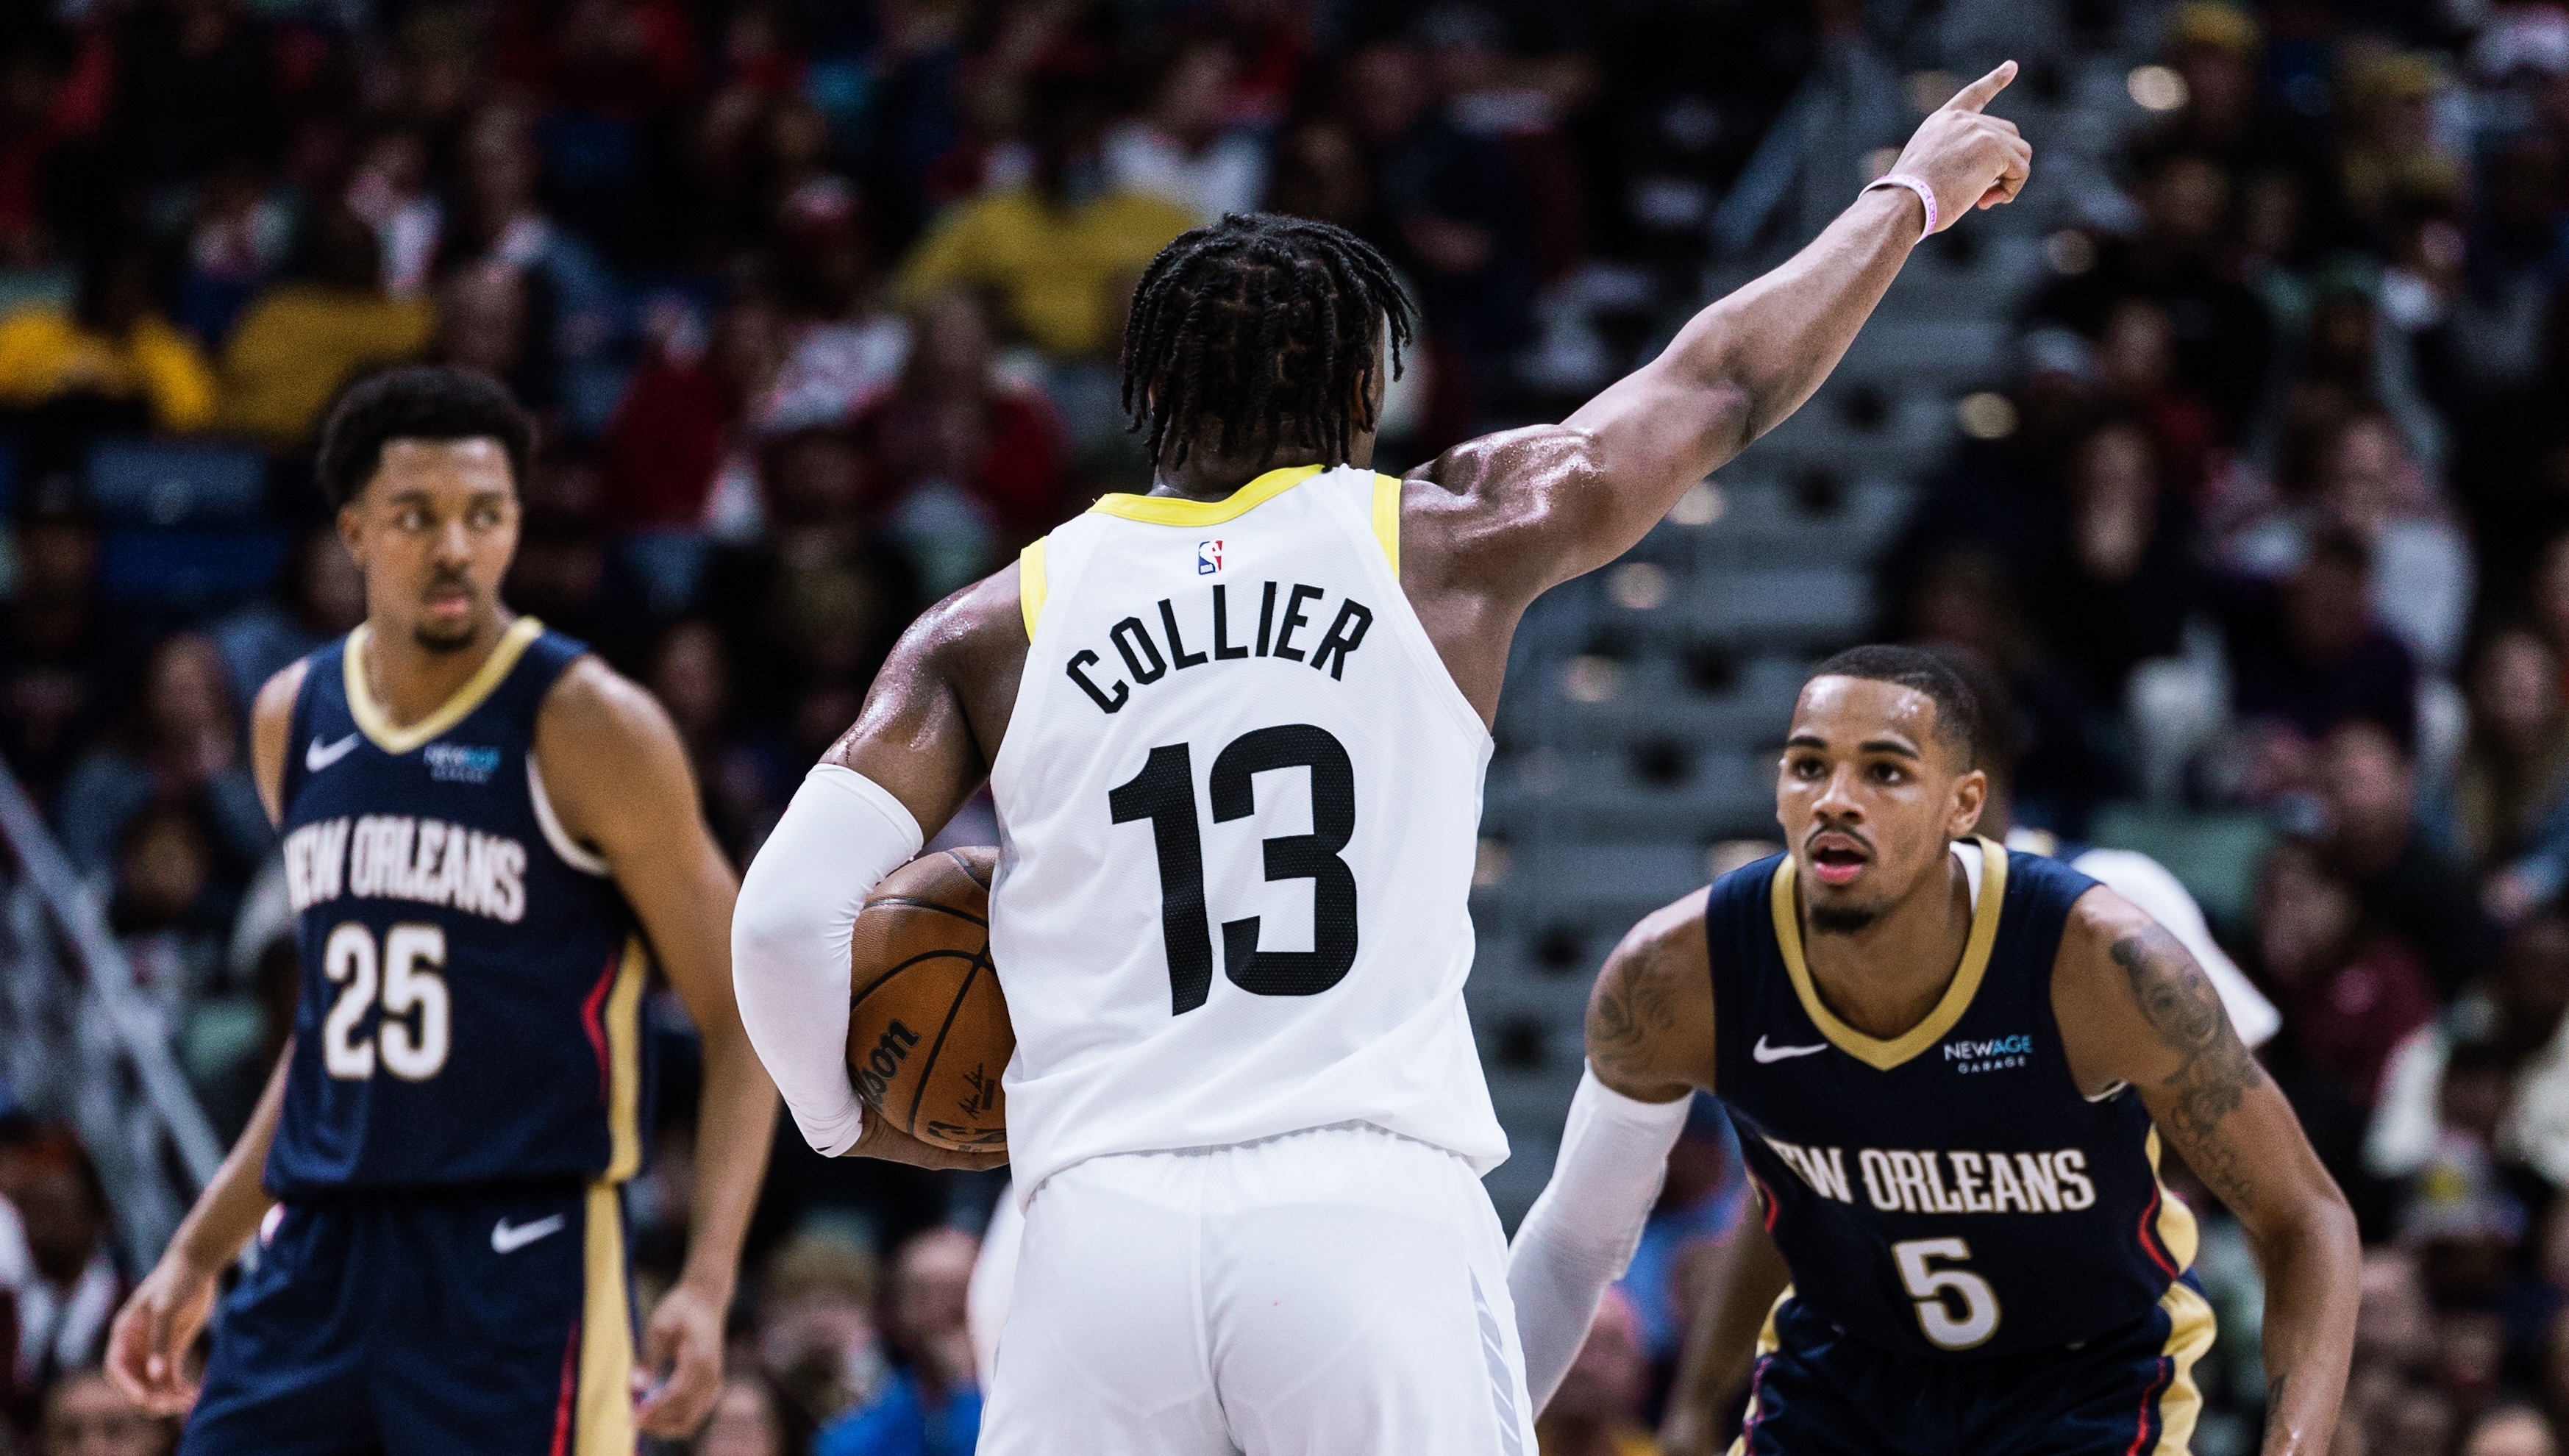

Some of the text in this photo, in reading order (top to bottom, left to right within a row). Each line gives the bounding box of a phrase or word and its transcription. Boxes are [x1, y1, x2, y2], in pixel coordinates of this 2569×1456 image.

[1066, 581, 1373, 714] COLLIER
[350, 814, 526, 923] ORLEANS
[1108, 724, 1358, 1017] 13
[324, 921, 451, 1081] 25
[847, 1020, 922, 1113] son
[1859, 1149, 2096, 1213] ORLEANS
[1892, 1237, 2001, 1350] 5
